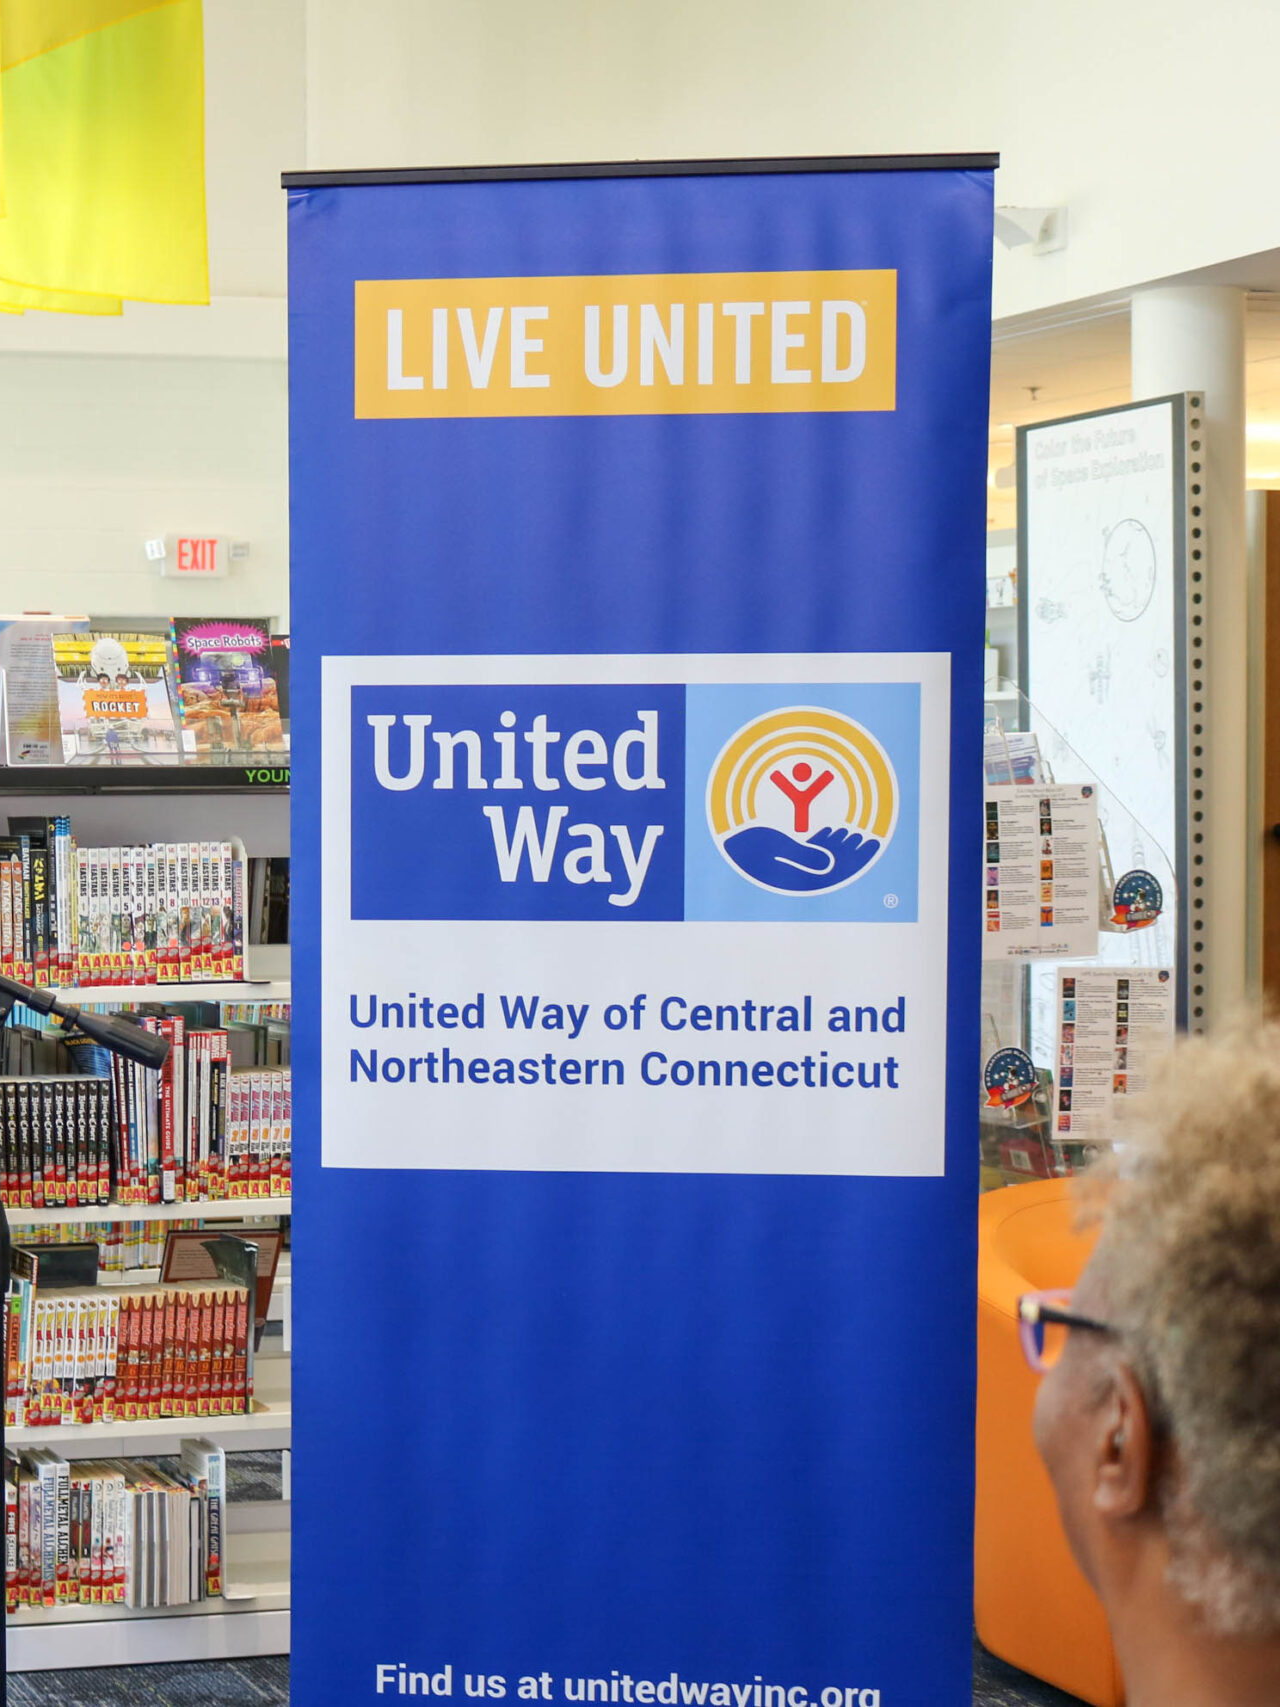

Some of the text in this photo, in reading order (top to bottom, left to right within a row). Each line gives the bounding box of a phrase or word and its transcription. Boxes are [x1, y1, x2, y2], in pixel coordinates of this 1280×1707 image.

[386, 300, 868, 391] LIVE UNITED
[177, 538, 218, 571] EXIT
[187, 634, 262, 652] Space Robots
[92, 701, 140, 713] ROCKET
[366, 709, 667, 792] United
[22, 847, 30, 880] BATMAN
[482, 805, 665, 908] Way
[348, 992, 908, 1040] United Way of Central and
[211, 1035, 219, 1059] MARVEL
[348, 1048, 900, 1090] Northeastern Connecticut
[10, 1315, 19, 1362] CLEMENTE
[57, 1475, 68, 1529] FULLMETAL
[7, 1511, 16, 1568] FIRE FORCE
[43, 1476, 55, 1581] FULLMETAL ALCHEMIS
[376, 1663, 881, 1707] Find us at unitedwayinc.org
